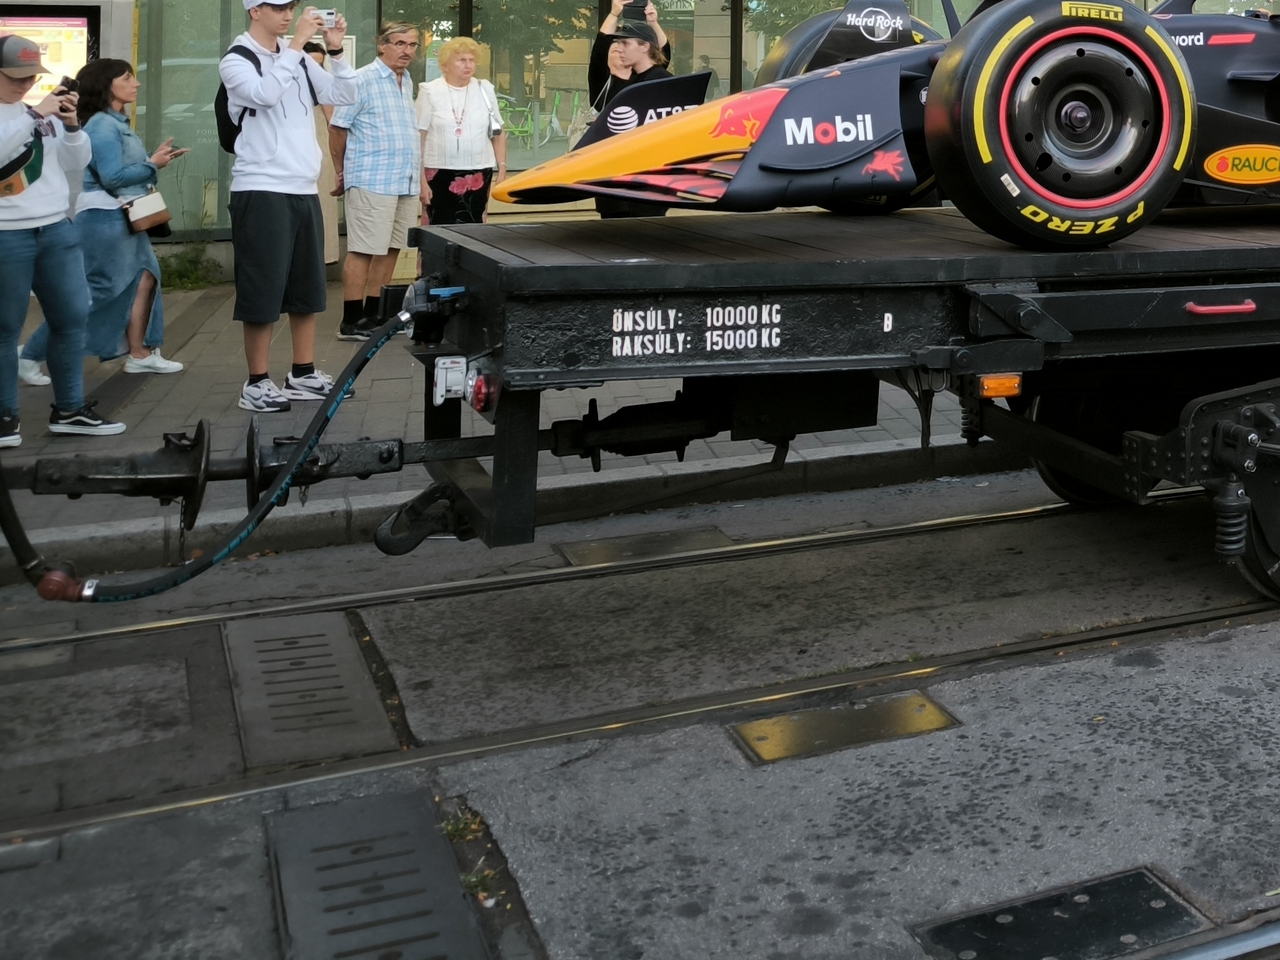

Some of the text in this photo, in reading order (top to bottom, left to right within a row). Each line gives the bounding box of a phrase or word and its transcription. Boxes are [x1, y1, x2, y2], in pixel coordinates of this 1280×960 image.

[846, 13, 903, 30] Hard Rock
[1061, 0, 1123, 22] PIRELLI
[643, 105, 699, 125] AT&
[784, 113, 873, 146] Mobil
[1020, 200, 1145, 235] P ZERO
[612, 304, 781, 333] ÖNSÚLY: 10000 KG
[612, 327, 781, 357] RAKSÚLY: 15000 KG
